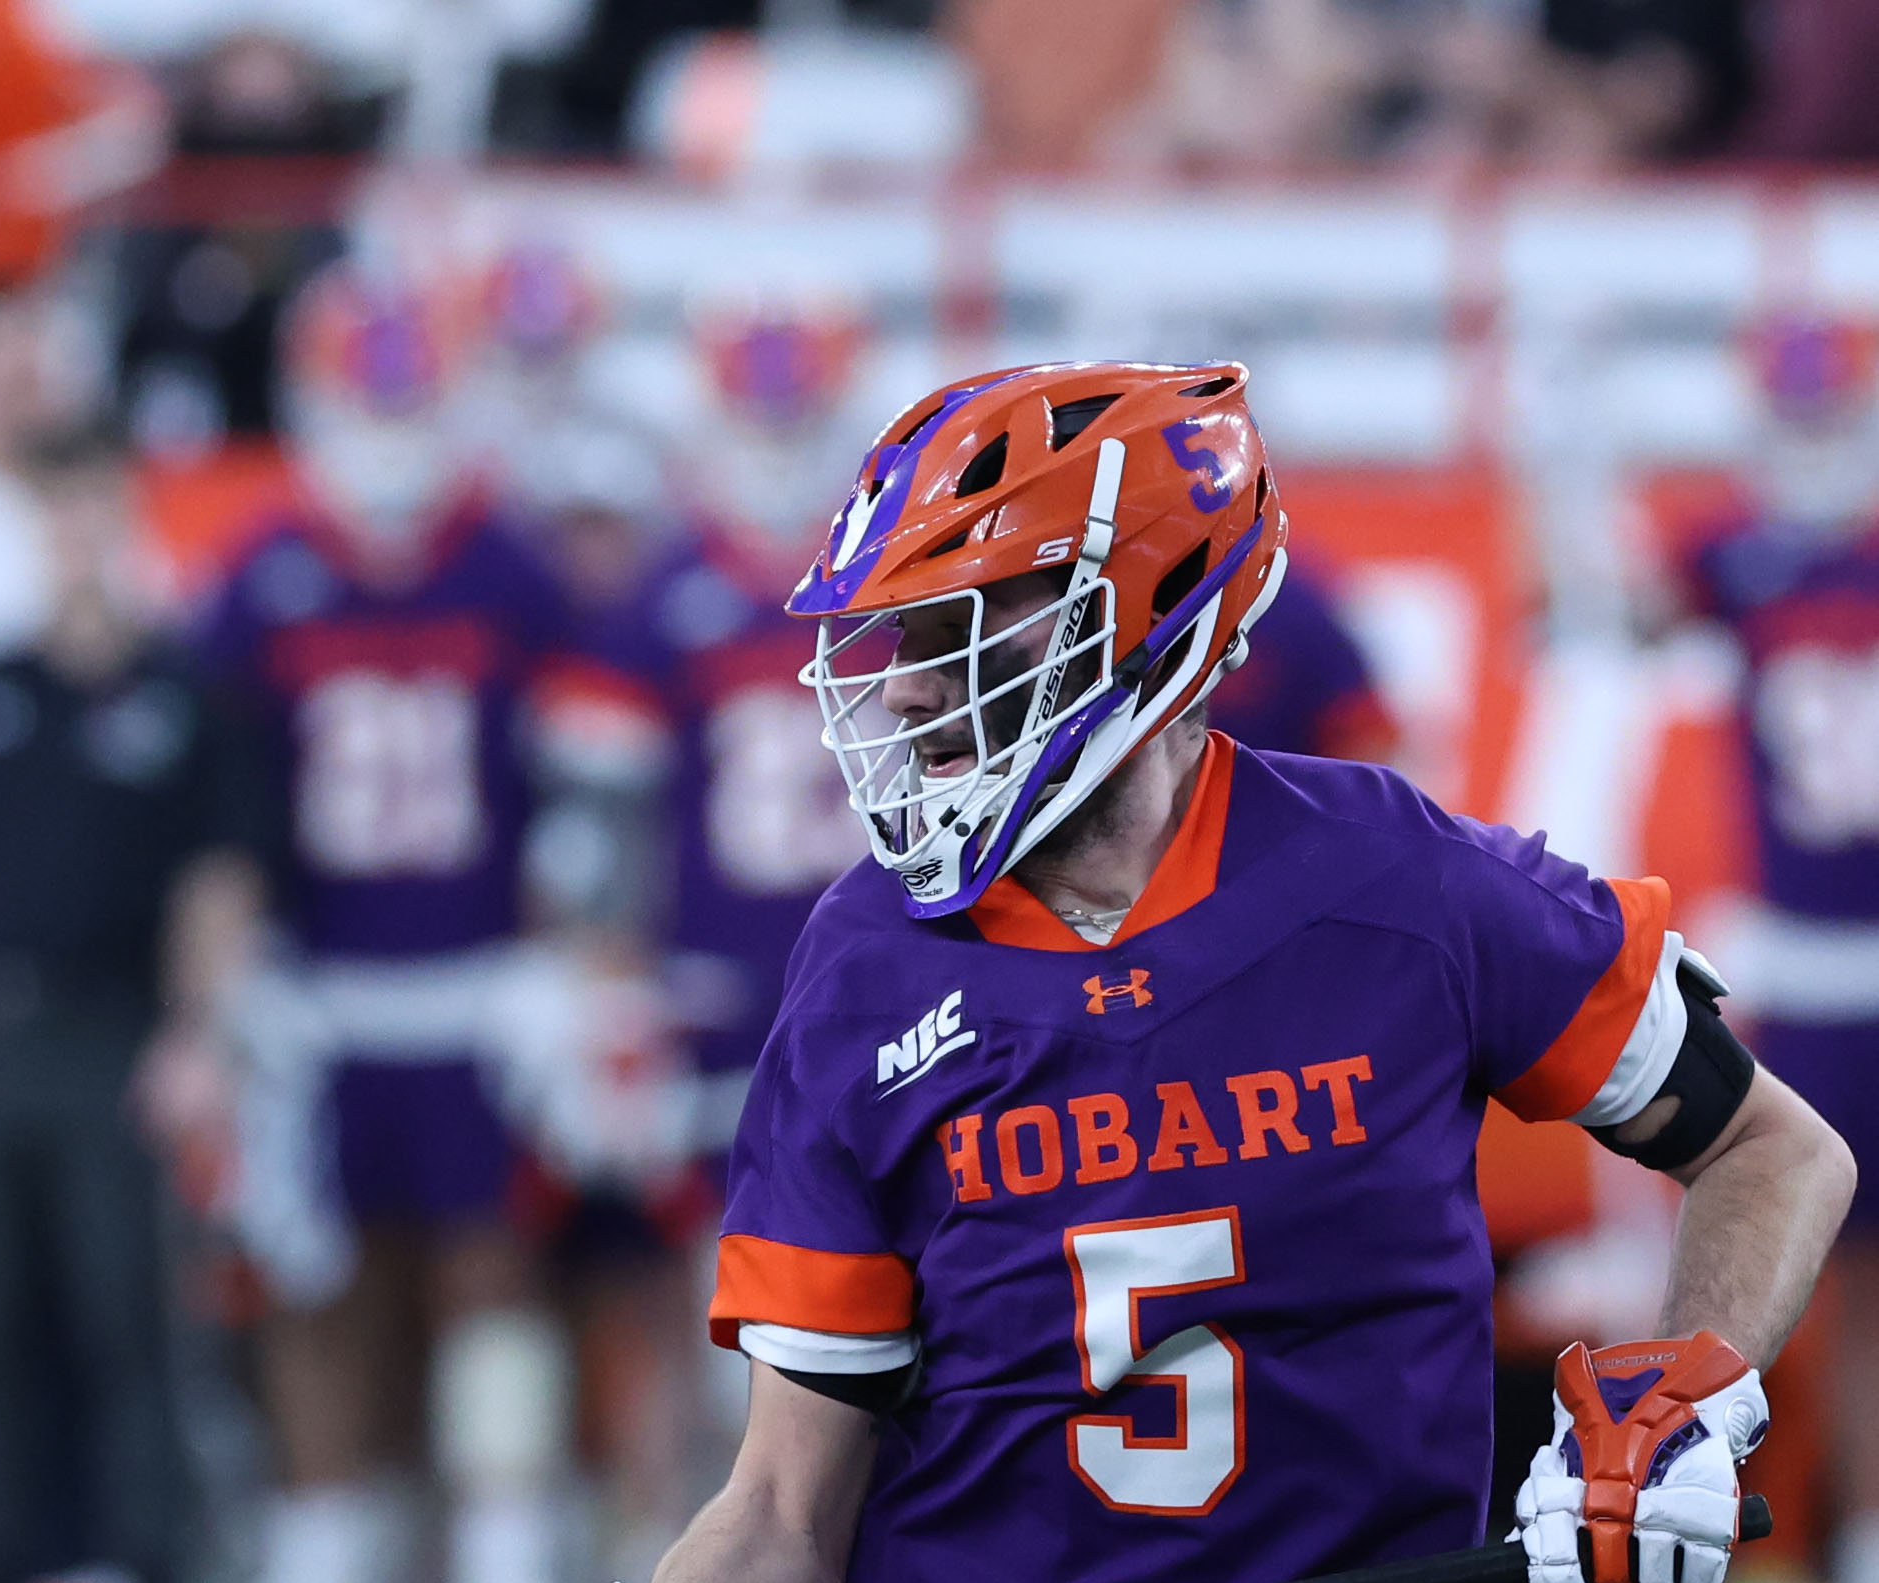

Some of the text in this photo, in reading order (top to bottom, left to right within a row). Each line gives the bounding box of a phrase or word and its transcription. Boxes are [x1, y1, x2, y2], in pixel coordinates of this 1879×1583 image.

[1162, 415, 1232, 514] 5
[877, 989, 962, 1085] NEC
[936, 1055, 1374, 1203] HOBART
[1064, 1205, 1246, 1517] 5
